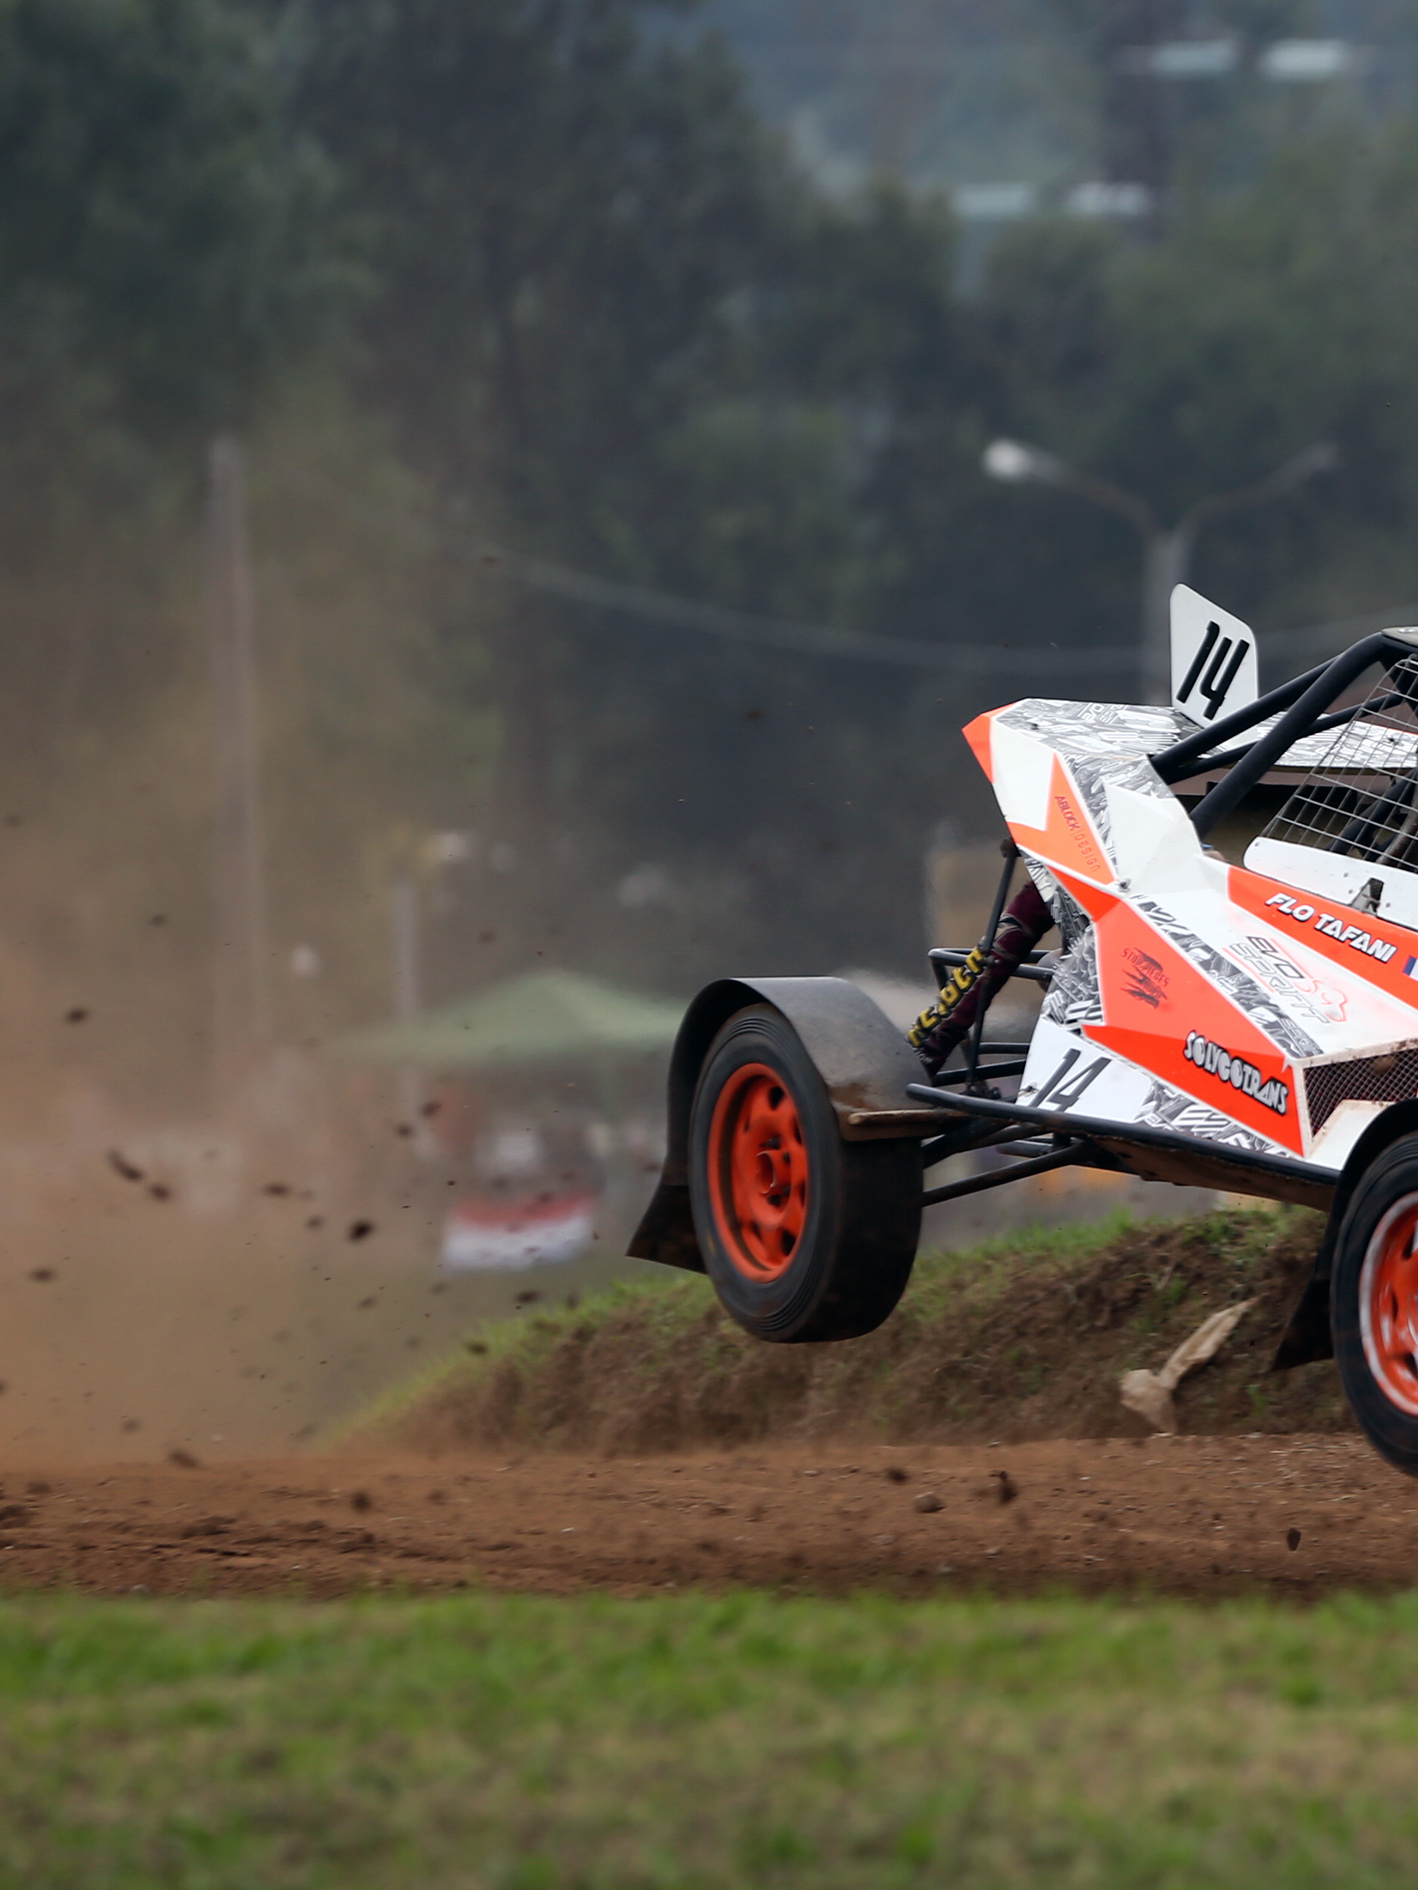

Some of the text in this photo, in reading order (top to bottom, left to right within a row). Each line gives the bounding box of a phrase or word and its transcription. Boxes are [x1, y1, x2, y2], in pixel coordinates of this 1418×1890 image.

[1176, 620, 1250, 721] 14
[1246, 935, 1305, 979] EVO
[1265, 892, 1398, 974] FLO TAFANI
[1027, 1048, 1112, 1113] 14
